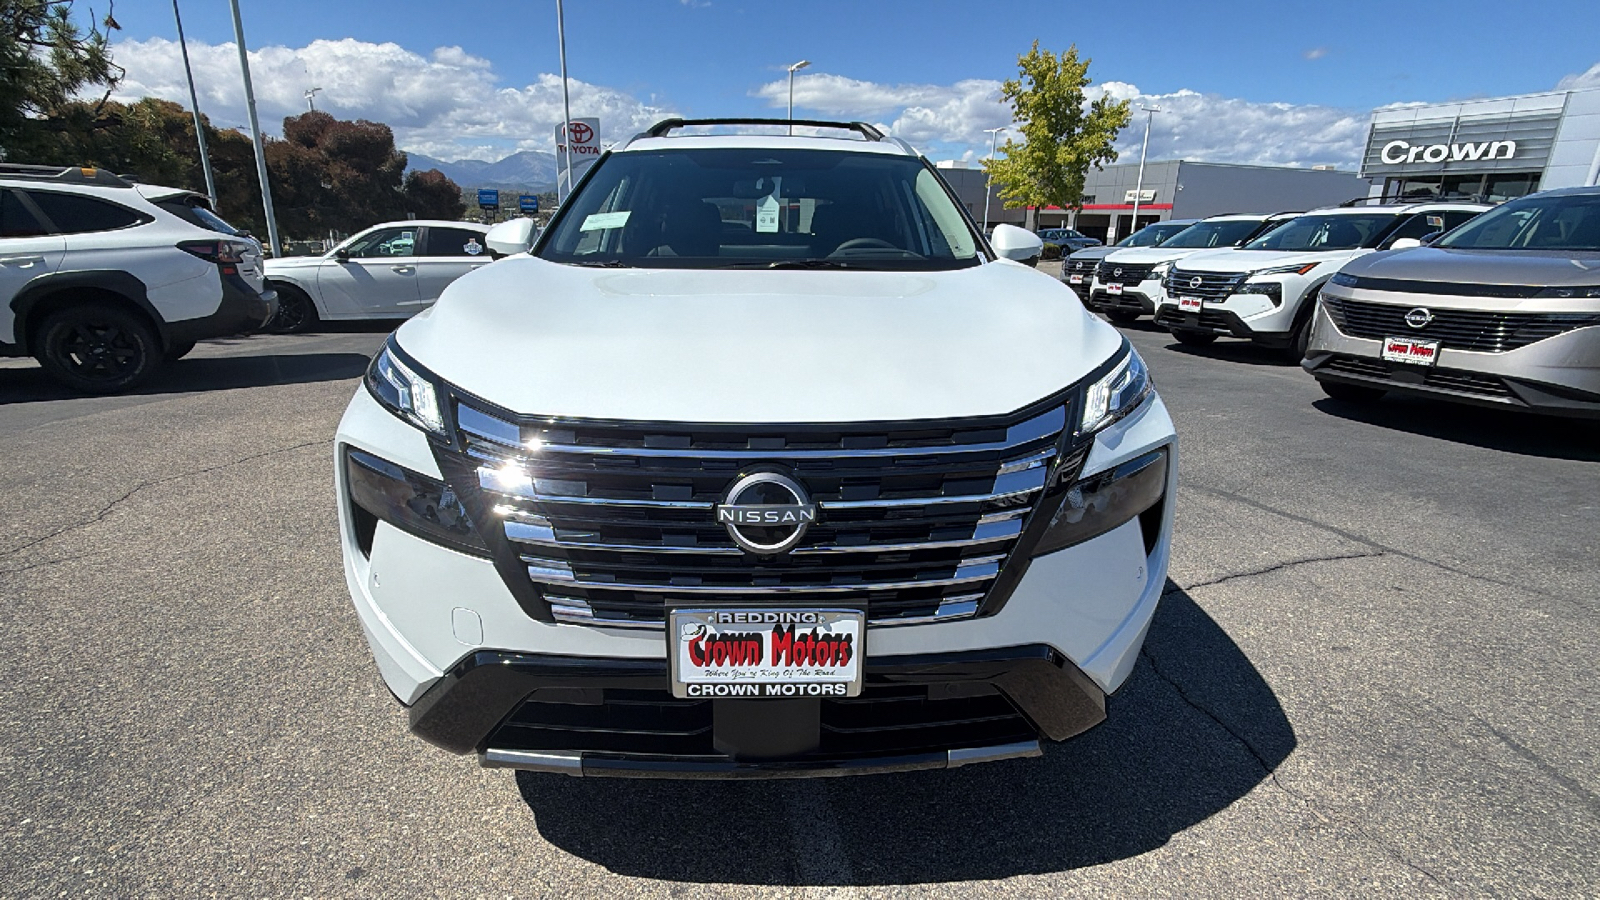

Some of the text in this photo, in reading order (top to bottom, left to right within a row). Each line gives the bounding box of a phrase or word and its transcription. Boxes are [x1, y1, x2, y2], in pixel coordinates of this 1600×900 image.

[1381, 140, 1516, 165] Crown
[719, 508, 814, 523] NISSAN
[718, 612, 817, 623] REDDING
[688, 625, 853, 667] Crown Motors
[704, 669, 728, 677] Where
[759, 669, 780, 678] King
[782, 669, 794, 678] Of
[796, 668, 810, 676] The
[688, 684, 847, 696] CROWN MOTORS
